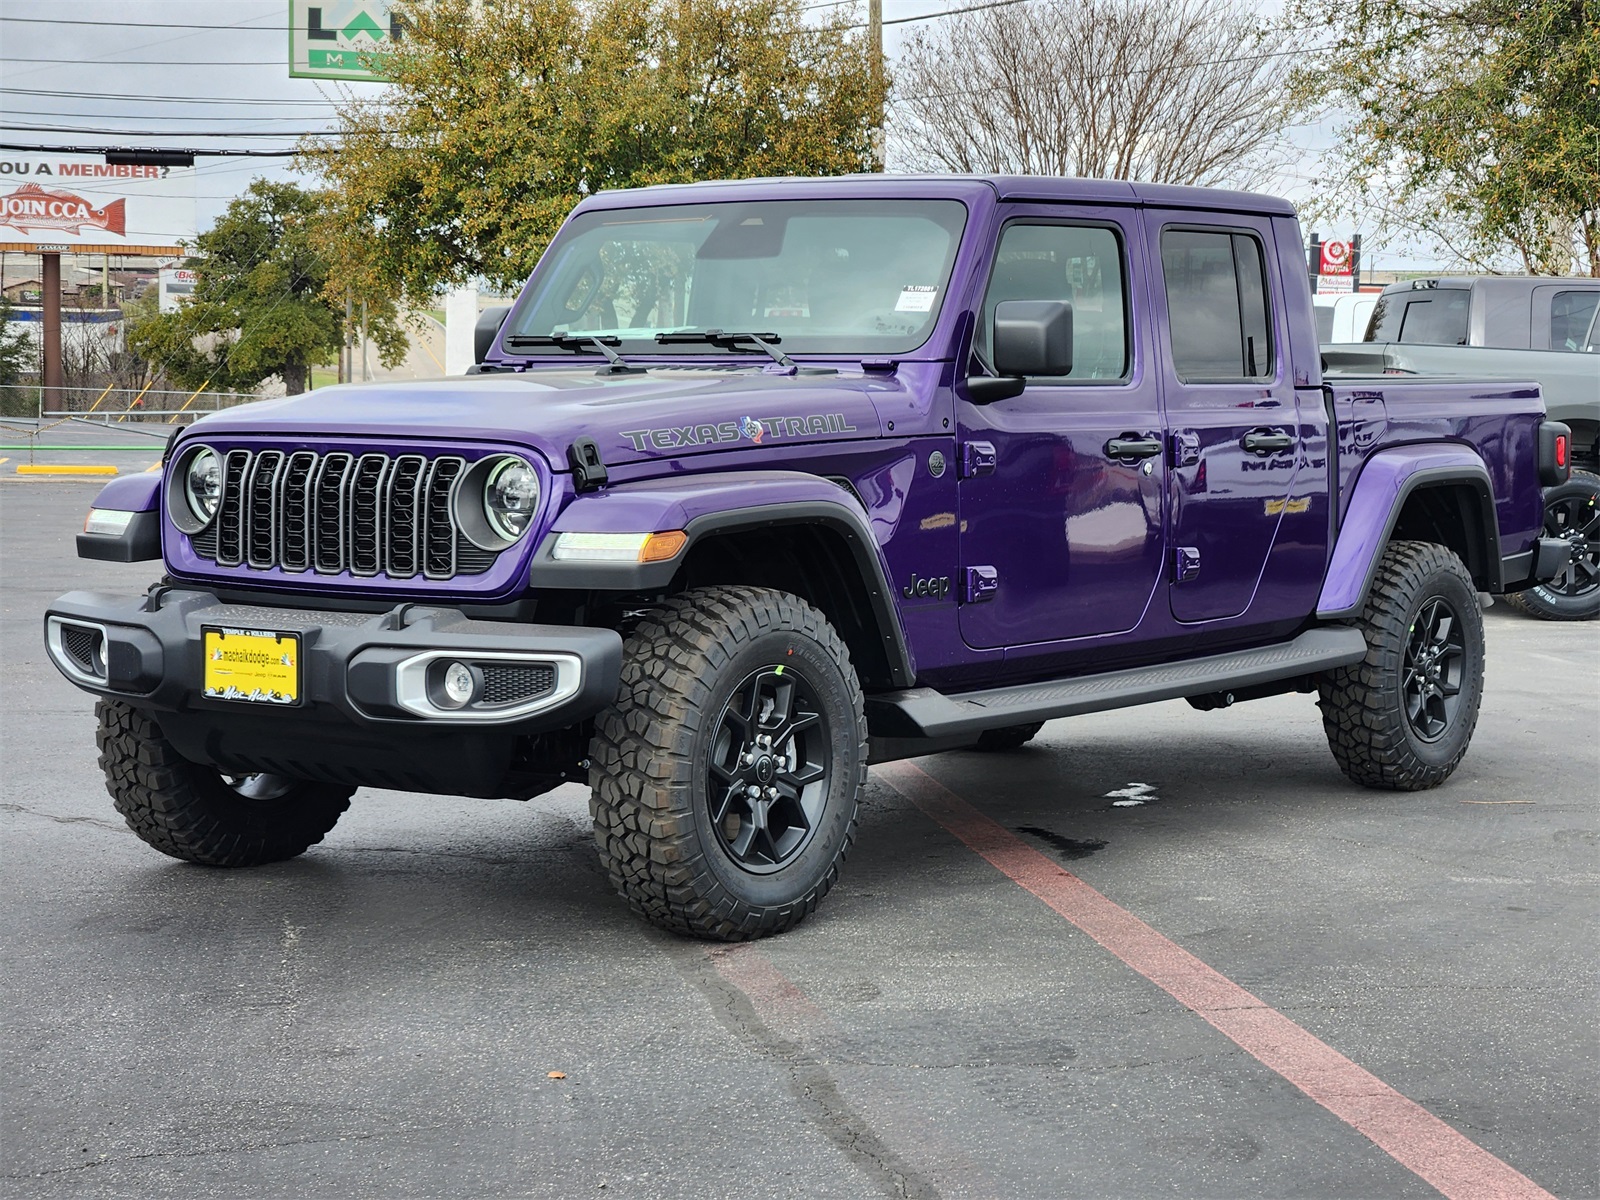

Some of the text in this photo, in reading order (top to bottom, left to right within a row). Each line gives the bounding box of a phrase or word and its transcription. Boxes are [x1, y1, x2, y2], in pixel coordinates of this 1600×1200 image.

[35, 163, 53, 175] A
[59, 163, 171, 179] MEMBER?
[0, 197, 91, 219] JOIN CCA
[619, 413, 856, 452] TEXAS TRAIL
[903, 573, 950, 601] Jeep
